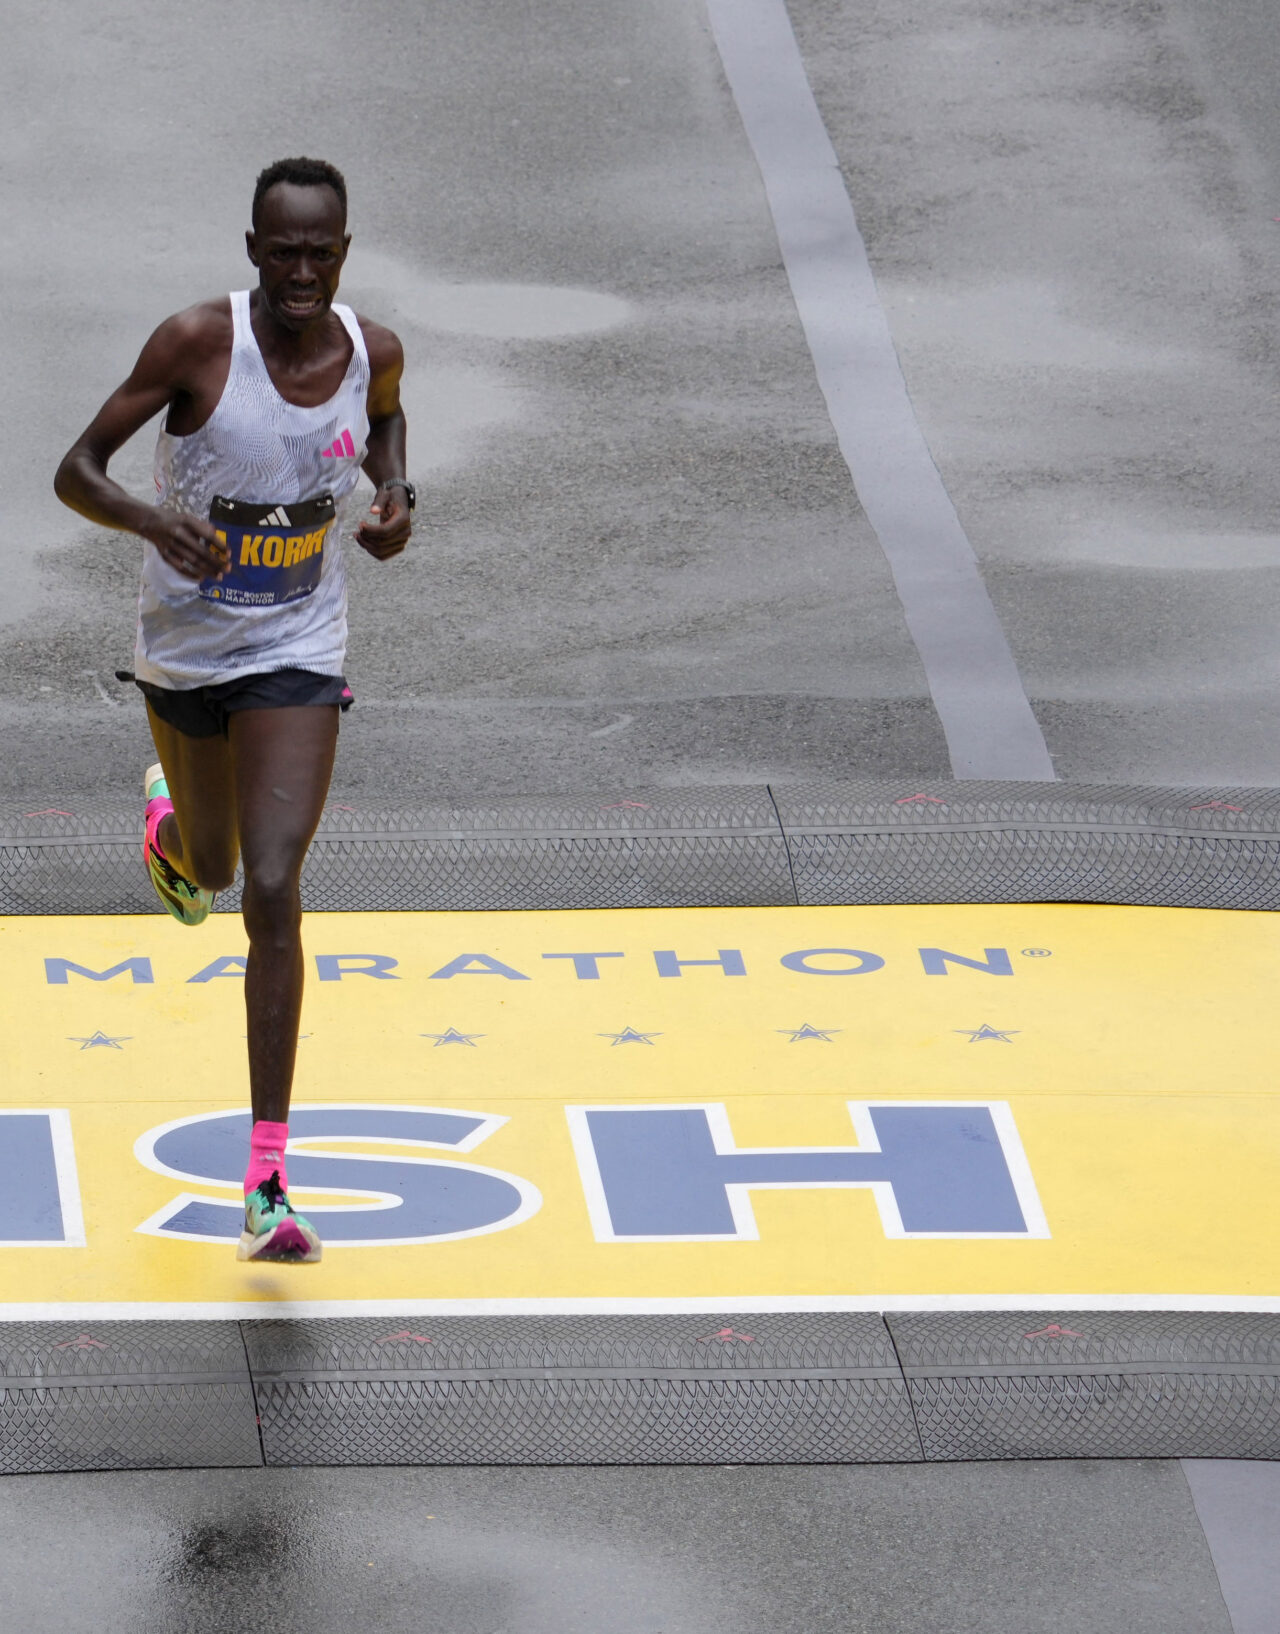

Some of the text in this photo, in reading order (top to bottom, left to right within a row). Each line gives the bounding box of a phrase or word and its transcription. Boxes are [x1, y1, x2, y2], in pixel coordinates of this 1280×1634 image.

[239, 527, 327, 568] KORIR
[244, 590, 275, 599] BOSTON
[225, 595, 274, 604] MARATHON
